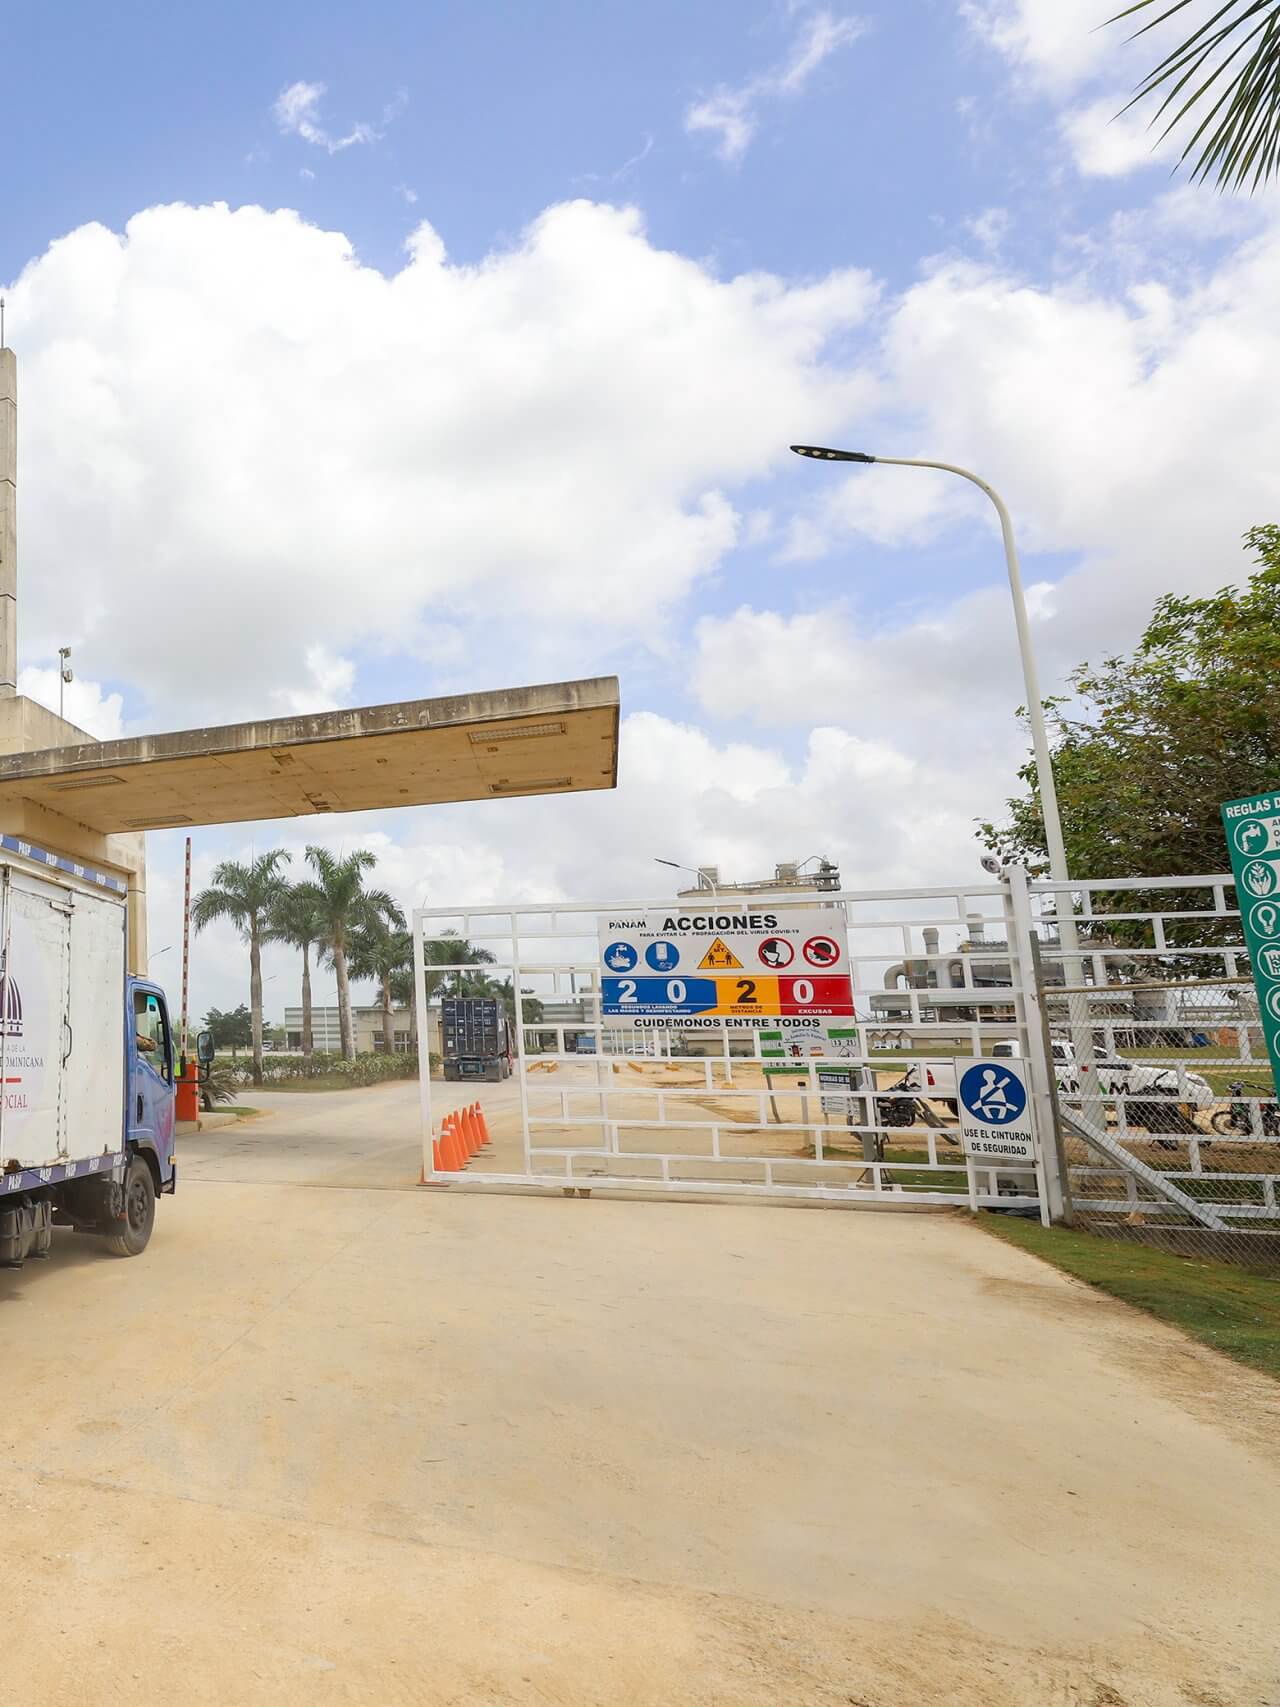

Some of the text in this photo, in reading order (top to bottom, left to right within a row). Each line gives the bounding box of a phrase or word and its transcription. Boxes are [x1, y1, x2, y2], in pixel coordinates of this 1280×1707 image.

[1226, 799, 1271, 818] REGLAS
[609, 921, 647, 929] PANAM
[662, 915, 778, 931] ACCIONES
[617, 979, 815, 1004] 2 0 2 0
[634, 1017, 821, 1027] CUIDÉMONOS ENTRE TODOS
[964, 1128, 979, 1138] USE
[980, 1129, 990, 1139] EL
[971, 1142, 1027, 1155] DE SEGURIDAD
